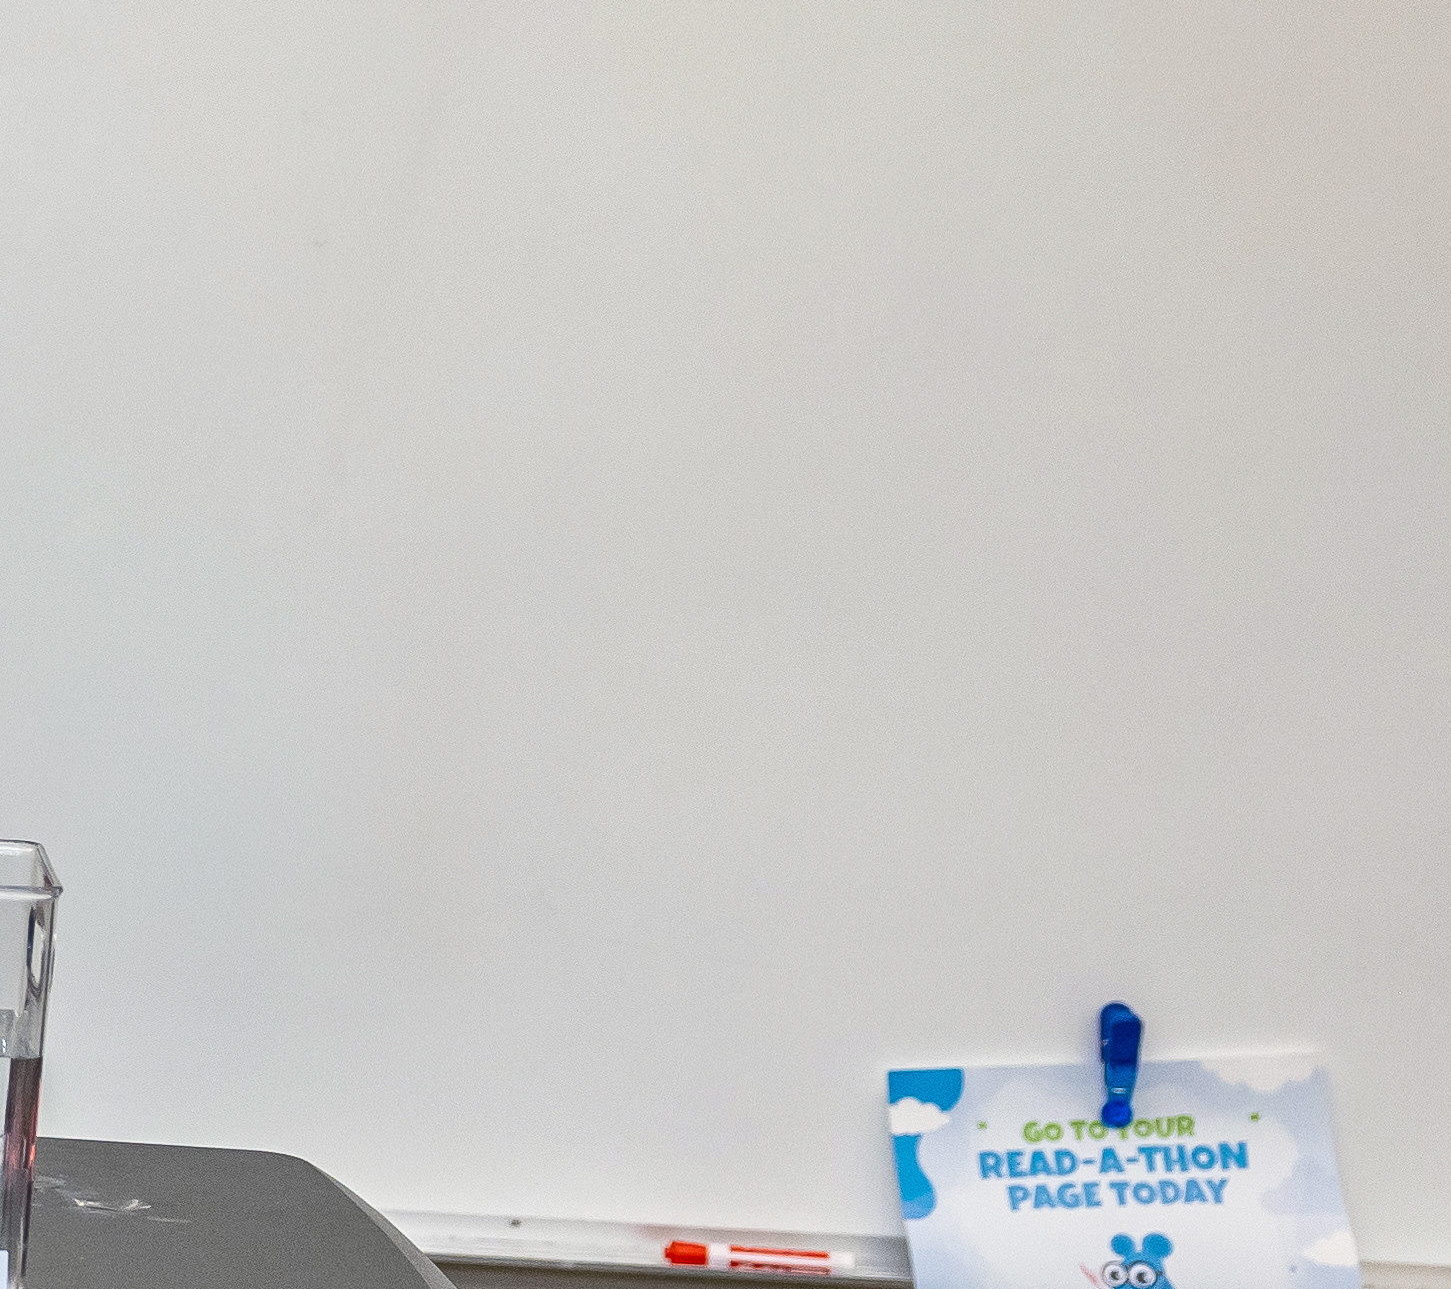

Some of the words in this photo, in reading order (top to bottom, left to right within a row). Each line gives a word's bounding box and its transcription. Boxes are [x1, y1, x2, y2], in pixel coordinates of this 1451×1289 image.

[1023, 1120, 1063, 1143] GO
[1069, 1120, 1108, 1141] TO
[978, 1141, 1248, 1179] READ-A-THON
[1008, 1182, 1102, 1212] PAGE
[1109, 1179, 1228, 1206] TODAY
